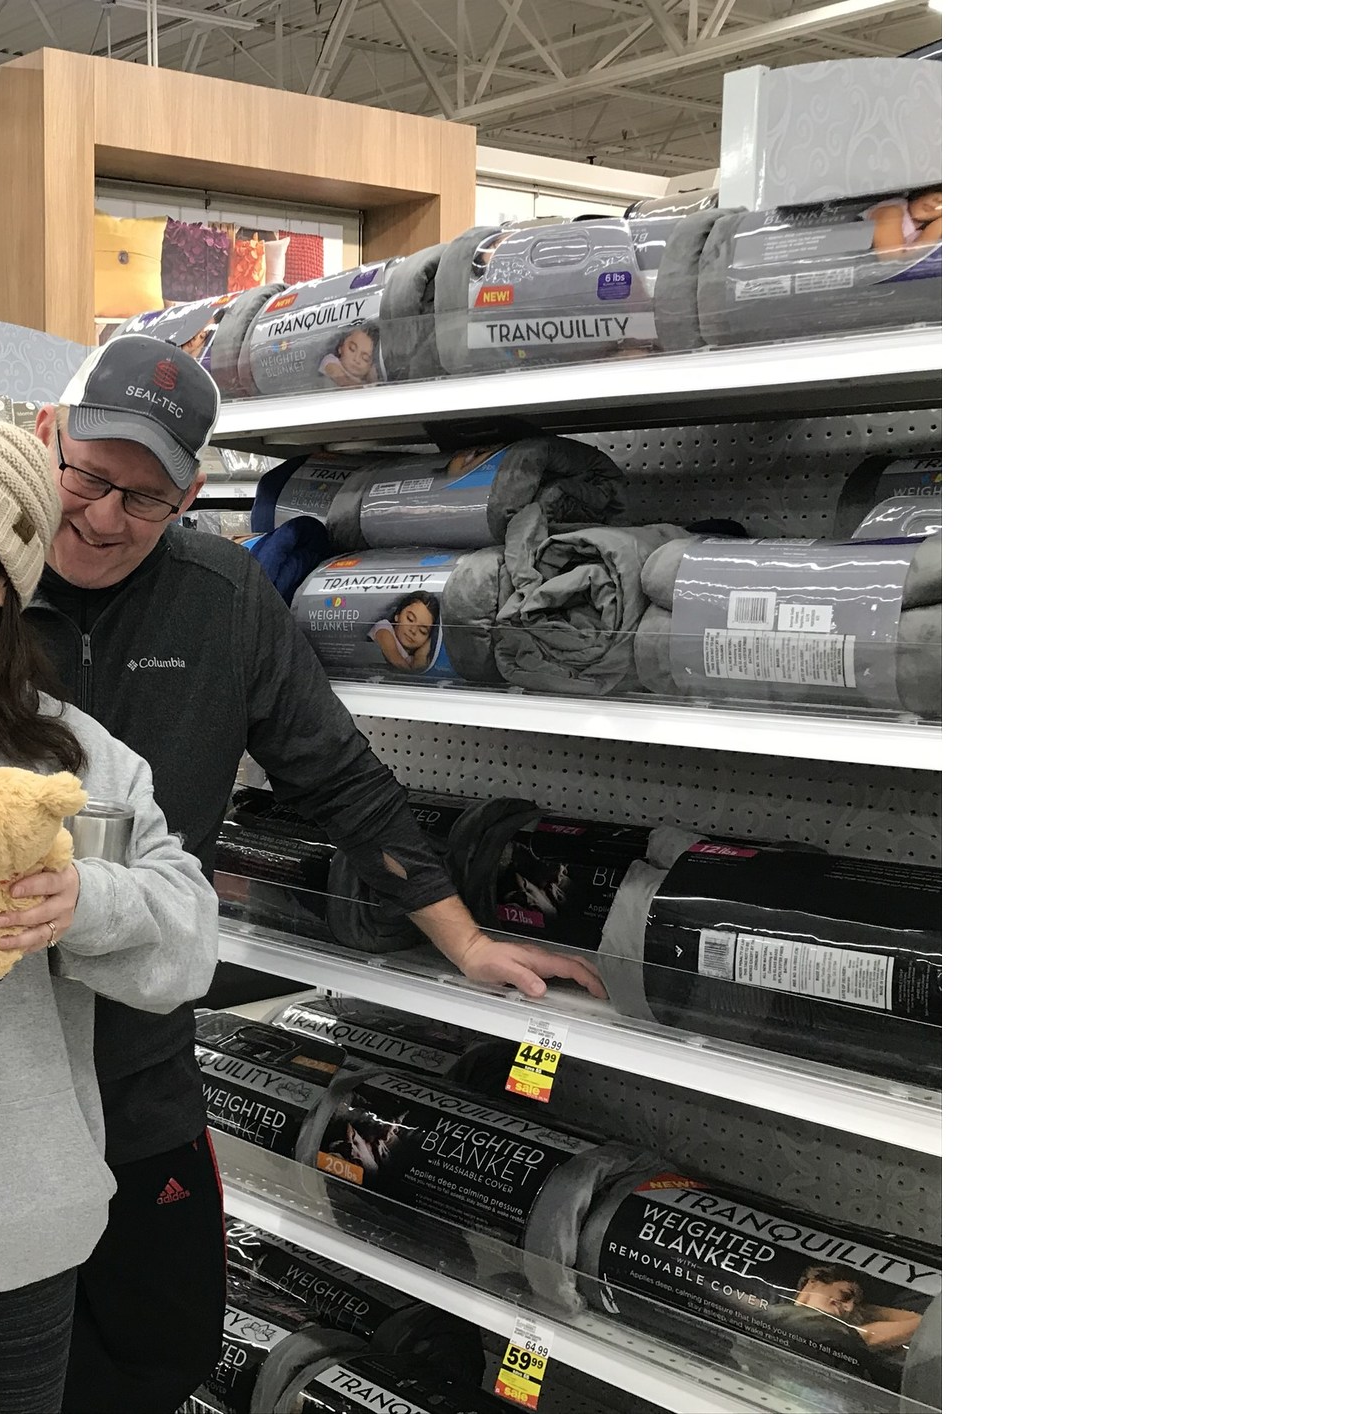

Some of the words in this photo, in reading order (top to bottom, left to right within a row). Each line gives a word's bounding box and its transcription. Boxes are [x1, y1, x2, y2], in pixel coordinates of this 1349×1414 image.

[605, 273, 612, 282] 6
[612, 272, 626, 282] lbs
[275, 296, 294, 308] NEW!
[483, 290, 510, 303] NEW!
[267, 299, 366, 337] TRANQUILITY
[486, 316, 629, 343] TRANQUILITY
[260, 350, 307, 368] WEIGHTED
[265, 361, 305, 378] BLANKET
[125, 385, 184, 419] SEAL-TEC
[310, 468, 351, 480] TRAN
[893, 486, 942, 496] WEIGH
[322, 574, 432, 592] TRANQUILITY
[308, 609, 360, 621] WEIGHTED
[310, 621, 356, 631] BLANKET
[139, 657, 186, 669] Columbia
[411, 808, 441, 823] TED
[700, 843, 738, 857] 12lbs
[592, 867, 621, 889] BL
[504, 908, 534, 925] 12lbs
[286, 1009, 415, 1058] TRANQUILITY
[538, 1037, 563, 1050] 49.99
[198, 1051, 282, 1089] QUILITY
[515, 1083, 541, 1096] sale
[201, 1083, 286, 1129] WEIGHTED
[380, 1077, 540, 1133] TRANQUILITY
[207, 1109, 282, 1149] LANKET
[434, 1117, 546, 1166] WEIGHTED
[324, 1156, 358, 1183] 20lbs
[420, 1132, 539, 1187] BLANKET
[427, 1156, 441, 1167] with
[440, 1160, 484, 1183] WASHABLE
[483, 1176, 514, 1194] COVER
[649, 1180, 697, 1191] NEW!
[157, 1190, 191, 1205] adidas
[408, 1166, 436, 1182] Applies
[436, 1176, 457, 1190] deep
[457, 1184, 489, 1203] calming
[489, 1197, 523, 1216] pressure
[643, 1203, 776, 1264] WEIGHTED
[670, 1188, 937, 1285] TRANQUILITY
[638, 1222, 758, 1277] BLANKET
[608, 1241, 706, 1287] REMOVABLE
[711, 1279, 770, 1311] COVER
[286, 1264, 371, 1316] WEIGHTED
[628, 1269, 655, 1284] Applies
[673, 1287, 703, 1304] calming
[701, 1298, 734, 1316] pressure
[733, 1310, 750, 1322] that
[750, 1317, 771, 1330] helps
[771, 1326, 788, 1337] you
[787, 1332, 808, 1344] relax
[808, 1339, 818, 1348] to
[817, 1343, 831, 1353] fall
[728, 1317, 743, 1328] and
[743, 1324, 764, 1336] wake
[222, 1342, 247, 1367] TED
[525, 1340, 549, 1357] 64.99
[331, 1370, 422, 1414] TRANQ
[504, 1387, 528, 1402] sale
